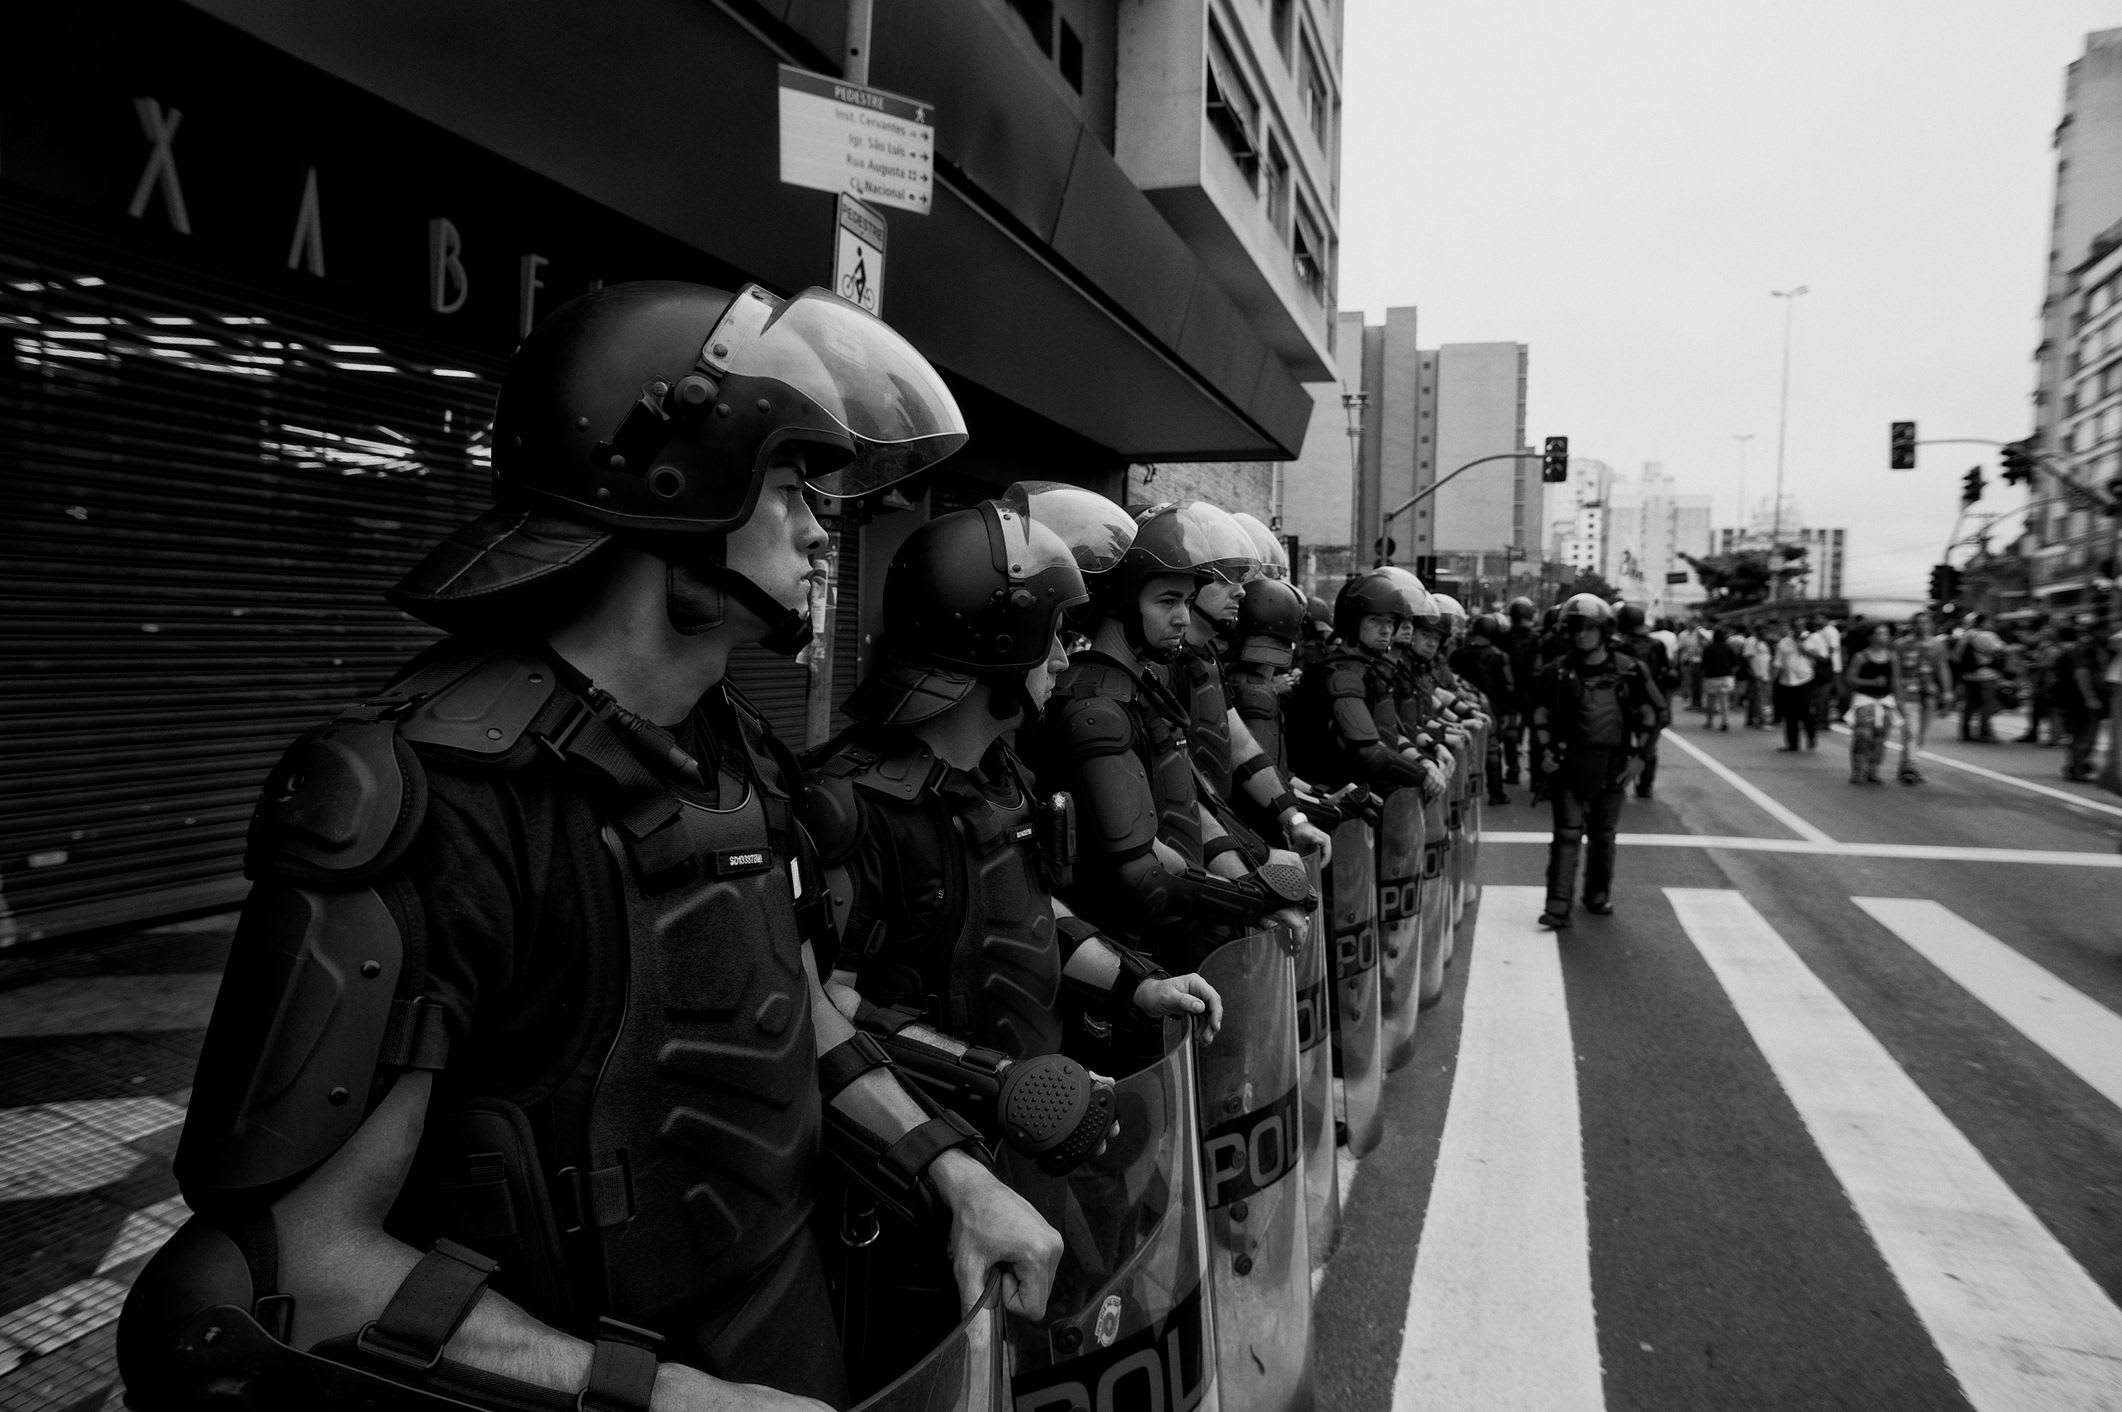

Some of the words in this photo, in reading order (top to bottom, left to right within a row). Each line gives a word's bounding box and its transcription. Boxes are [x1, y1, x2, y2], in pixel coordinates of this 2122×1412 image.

[834, 86, 885, 110] PEDESTRE
[859, 113, 906, 136] Cervantes
[846, 153, 865, 168] Rua
[867, 160, 905, 178] Augusta
[865, 180, 905, 199] Nacional
[841, 203, 882, 241] PEDESTRE
